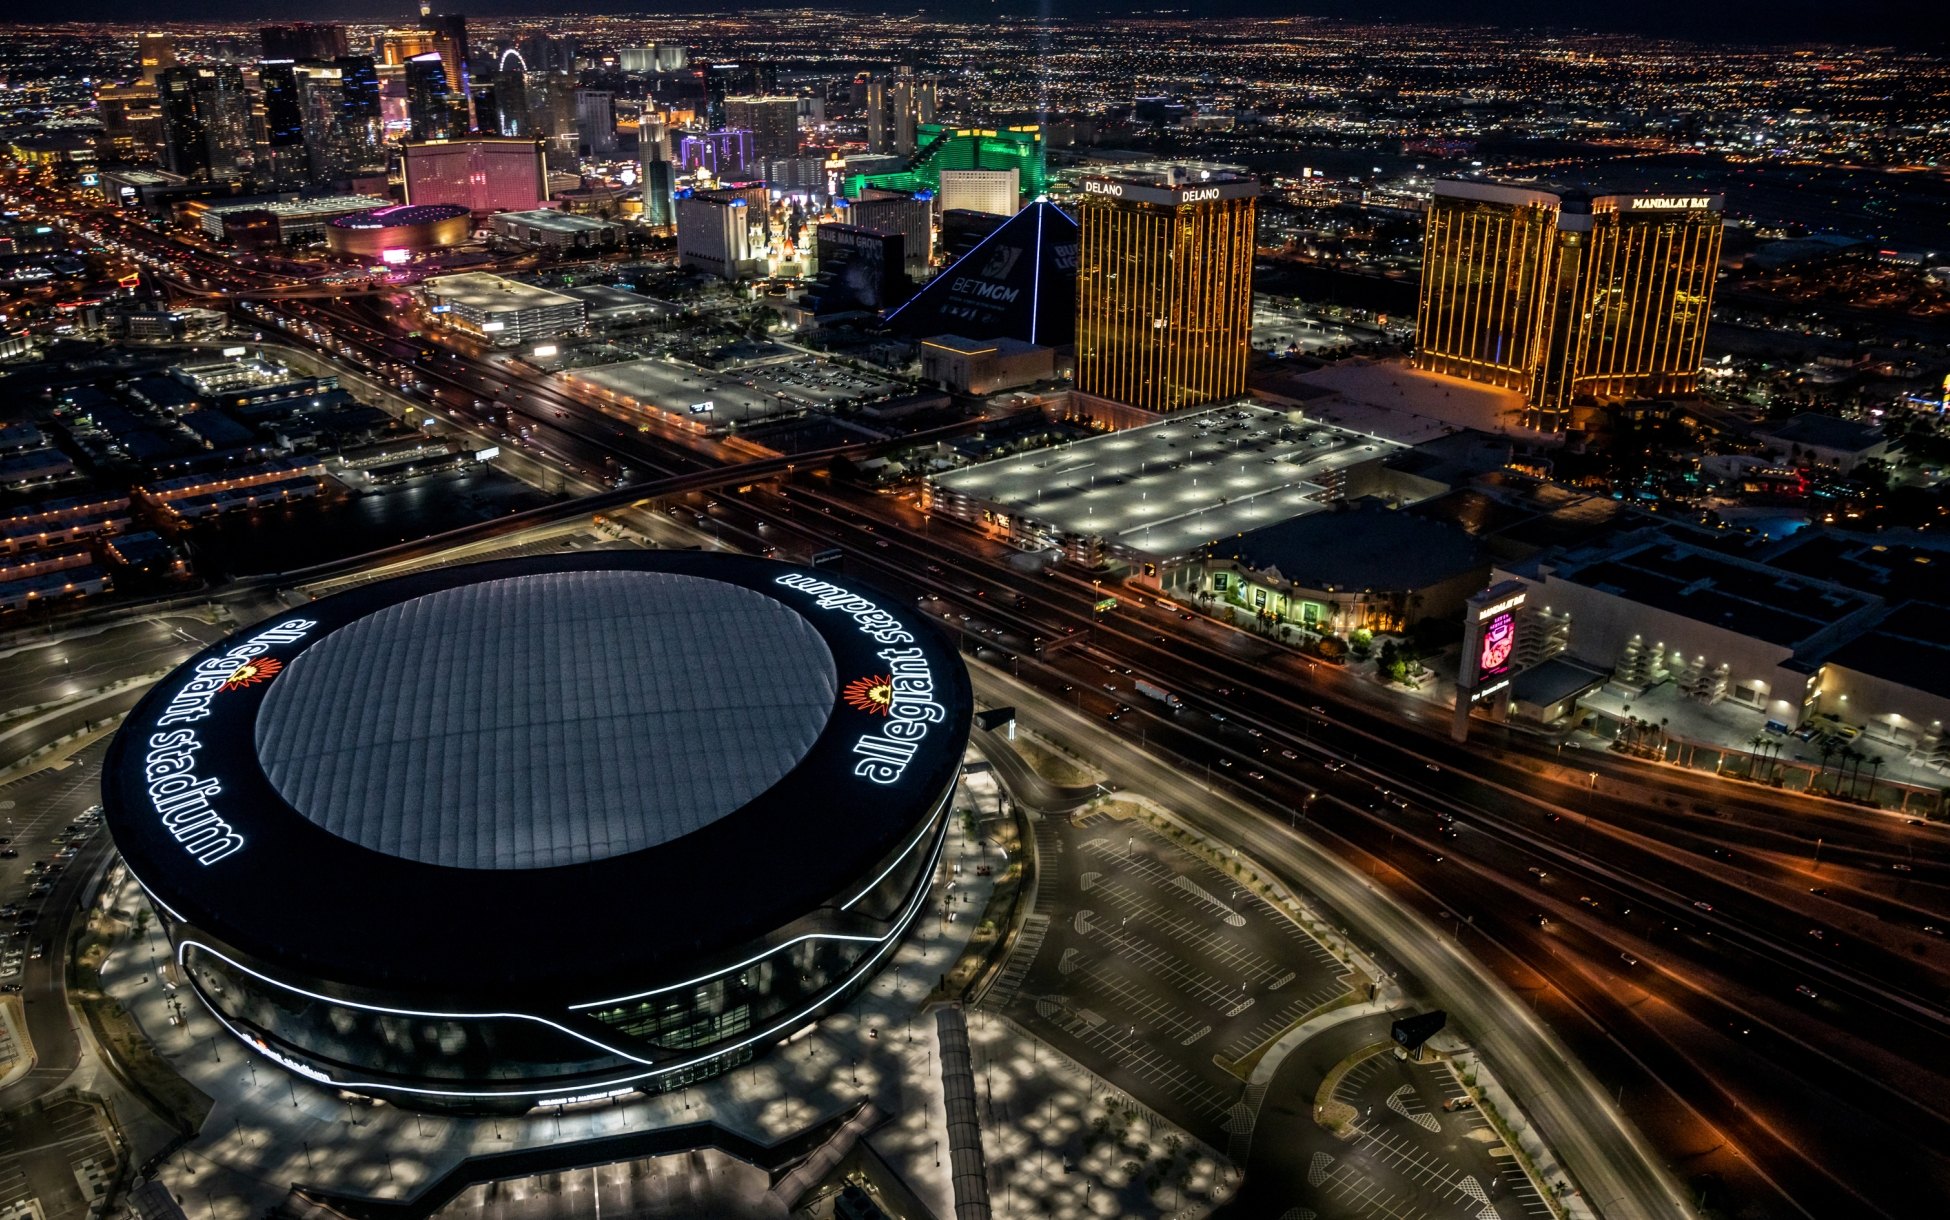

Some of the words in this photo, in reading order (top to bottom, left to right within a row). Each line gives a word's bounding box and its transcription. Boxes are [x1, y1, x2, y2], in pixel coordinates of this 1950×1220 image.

[825, 159, 846, 169] MGM
[1086, 181, 1123, 197] DELANO
[1182, 188, 1220, 202] DELANO
[1632, 198, 1690, 209] MANDALAY
[1690, 197, 1711, 208] BAY
[819, 229, 836, 242] BLUE
[838, 234, 855, 246] MAN
[856, 237, 883, 250] GROUP
[1054, 243, 1078, 257] BU
[951, 277, 1020, 303] BETMGM
[776, 573, 914, 643] stadium
[157, 618, 317, 726] allegiant
[853, 647, 945, 784] allegiant
[145, 728, 244, 866] stadium
